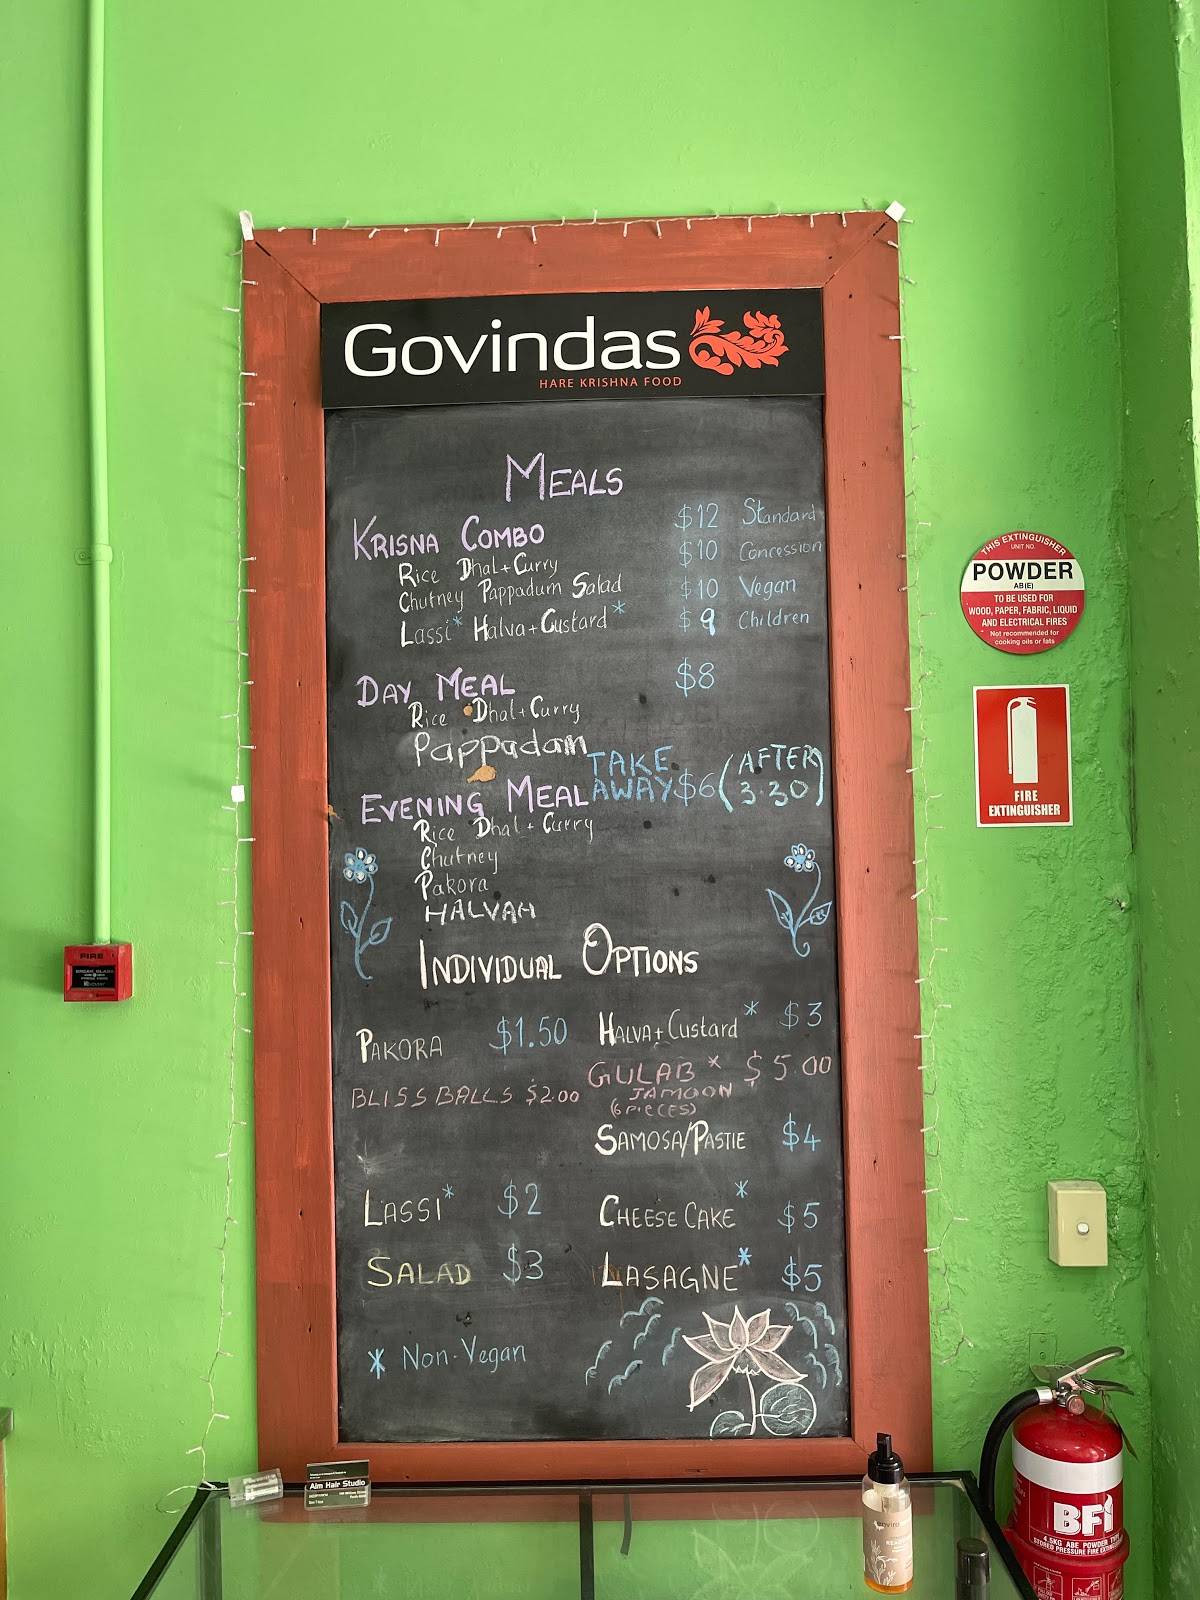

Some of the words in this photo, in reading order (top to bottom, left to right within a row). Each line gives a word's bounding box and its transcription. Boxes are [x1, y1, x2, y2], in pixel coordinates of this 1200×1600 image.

[344, 315, 681, 377] Govindas
[539, 378, 574, 389] HARE
[579, 377, 639, 388] KRISHNA
[643, 376, 682, 387] FOOD
[505, 452, 624, 502] MEALS
[674, 503, 719, 532] $12
[742, 497, 816, 525] Standard
[353, 515, 440, 561] KRISNA
[461, 515, 545, 551] COMBO
[981, 539, 1001, 556] THIS
[1001, 532, 1067, 556] EXTINGUISHER
[679, 538, 718, 568] $10
[739, 540, 823, 562] Concession
[398, 562, 440, 588] Rice
[973, 561, 1074, 581] POWDER
[398, 589, 465, 614] Chutney
[477, 577, 562, 605] Pappadum
[571, 571, 622, 599] Salad
[680, 575, 719, 600] $10
[739, 576, 796, 601] Vegan
[994, 595, 1004, 603] TO
[1006, 595, 1016, 603] BE
[1017, 594, 1037, 603] USED
[1039, 594, 1054, 602] FOR
[678, 606, 716, 636] $9
[738, 608, 810, 630] Children
[968, 606, 994, 616] WOOD,
[995, 606, 1021, 615] PAPER,
[1022, 606, 1052, 614] FABRIC,
[1053, 605, 1078, 614] LIQUID
[982, 619, 998, 627] AND
[999, 618, 1044, 626] ELECTRICAL
[1046, 617, 1068, 626] FIRES
[356, 675, 413, 707] DAY
[436, 667, 516, 701] MEAL
[675, 657, 715, 698] $8
[408, 702, 450, 728] Rice
[587, 746, 673, 778] TAKE
[360, 793, 485, 825] EVENING
[507, 776, 590, 813] MEAL
[591, 776, 674, 804] AWAY
[673, 768, 717, 807] $6
[1014, 790, 1039, 802] FIRE
[988, 804, 1061, 817] EXTINGUISHER
[413, 819, 456, 847] Rice
[420, 846, 499, 875] Chutney
[414, 870, 489, 901] Pakora
[424, 899, 537, 926] HALVAH
[418, 938, 563, 991] INDIVIDUAL
[582, 922, 700, 977] OPTIONS
[356, 1028, 443, 1064] PAKORA
[489, 1016, 568, 1056] $1.50
[587, 1061, 696, 1089] GULAB
[351, 1085, 428, 1110] BLISS
[436, 1085, 513, 1106] BALLS
[629, 1082, 733, 1101] JAMOON
[782, 1112, 821, 1152] $4
[497, 1178, 542, 1219] $2
[777, 1200, 820, 1234] $5
[367, 1256, 473, 1287] SALAD
[503, 1243, 544, 1286] $3
[601, 1251, 738, 1293] LASAGNE
[782, 1256, 823, 1292] $5
[325, 1481, 341, 1489] Hair
[342, 1479, 366, 1487] Studio
[1033, 1537, 1055, 1551] STORED
[1055, 1545, 1086, 1555] PRESSURE
[1066, 1541, 1080, 1549] ABE
[1082, 1539, 1109, 1549] POWDER
